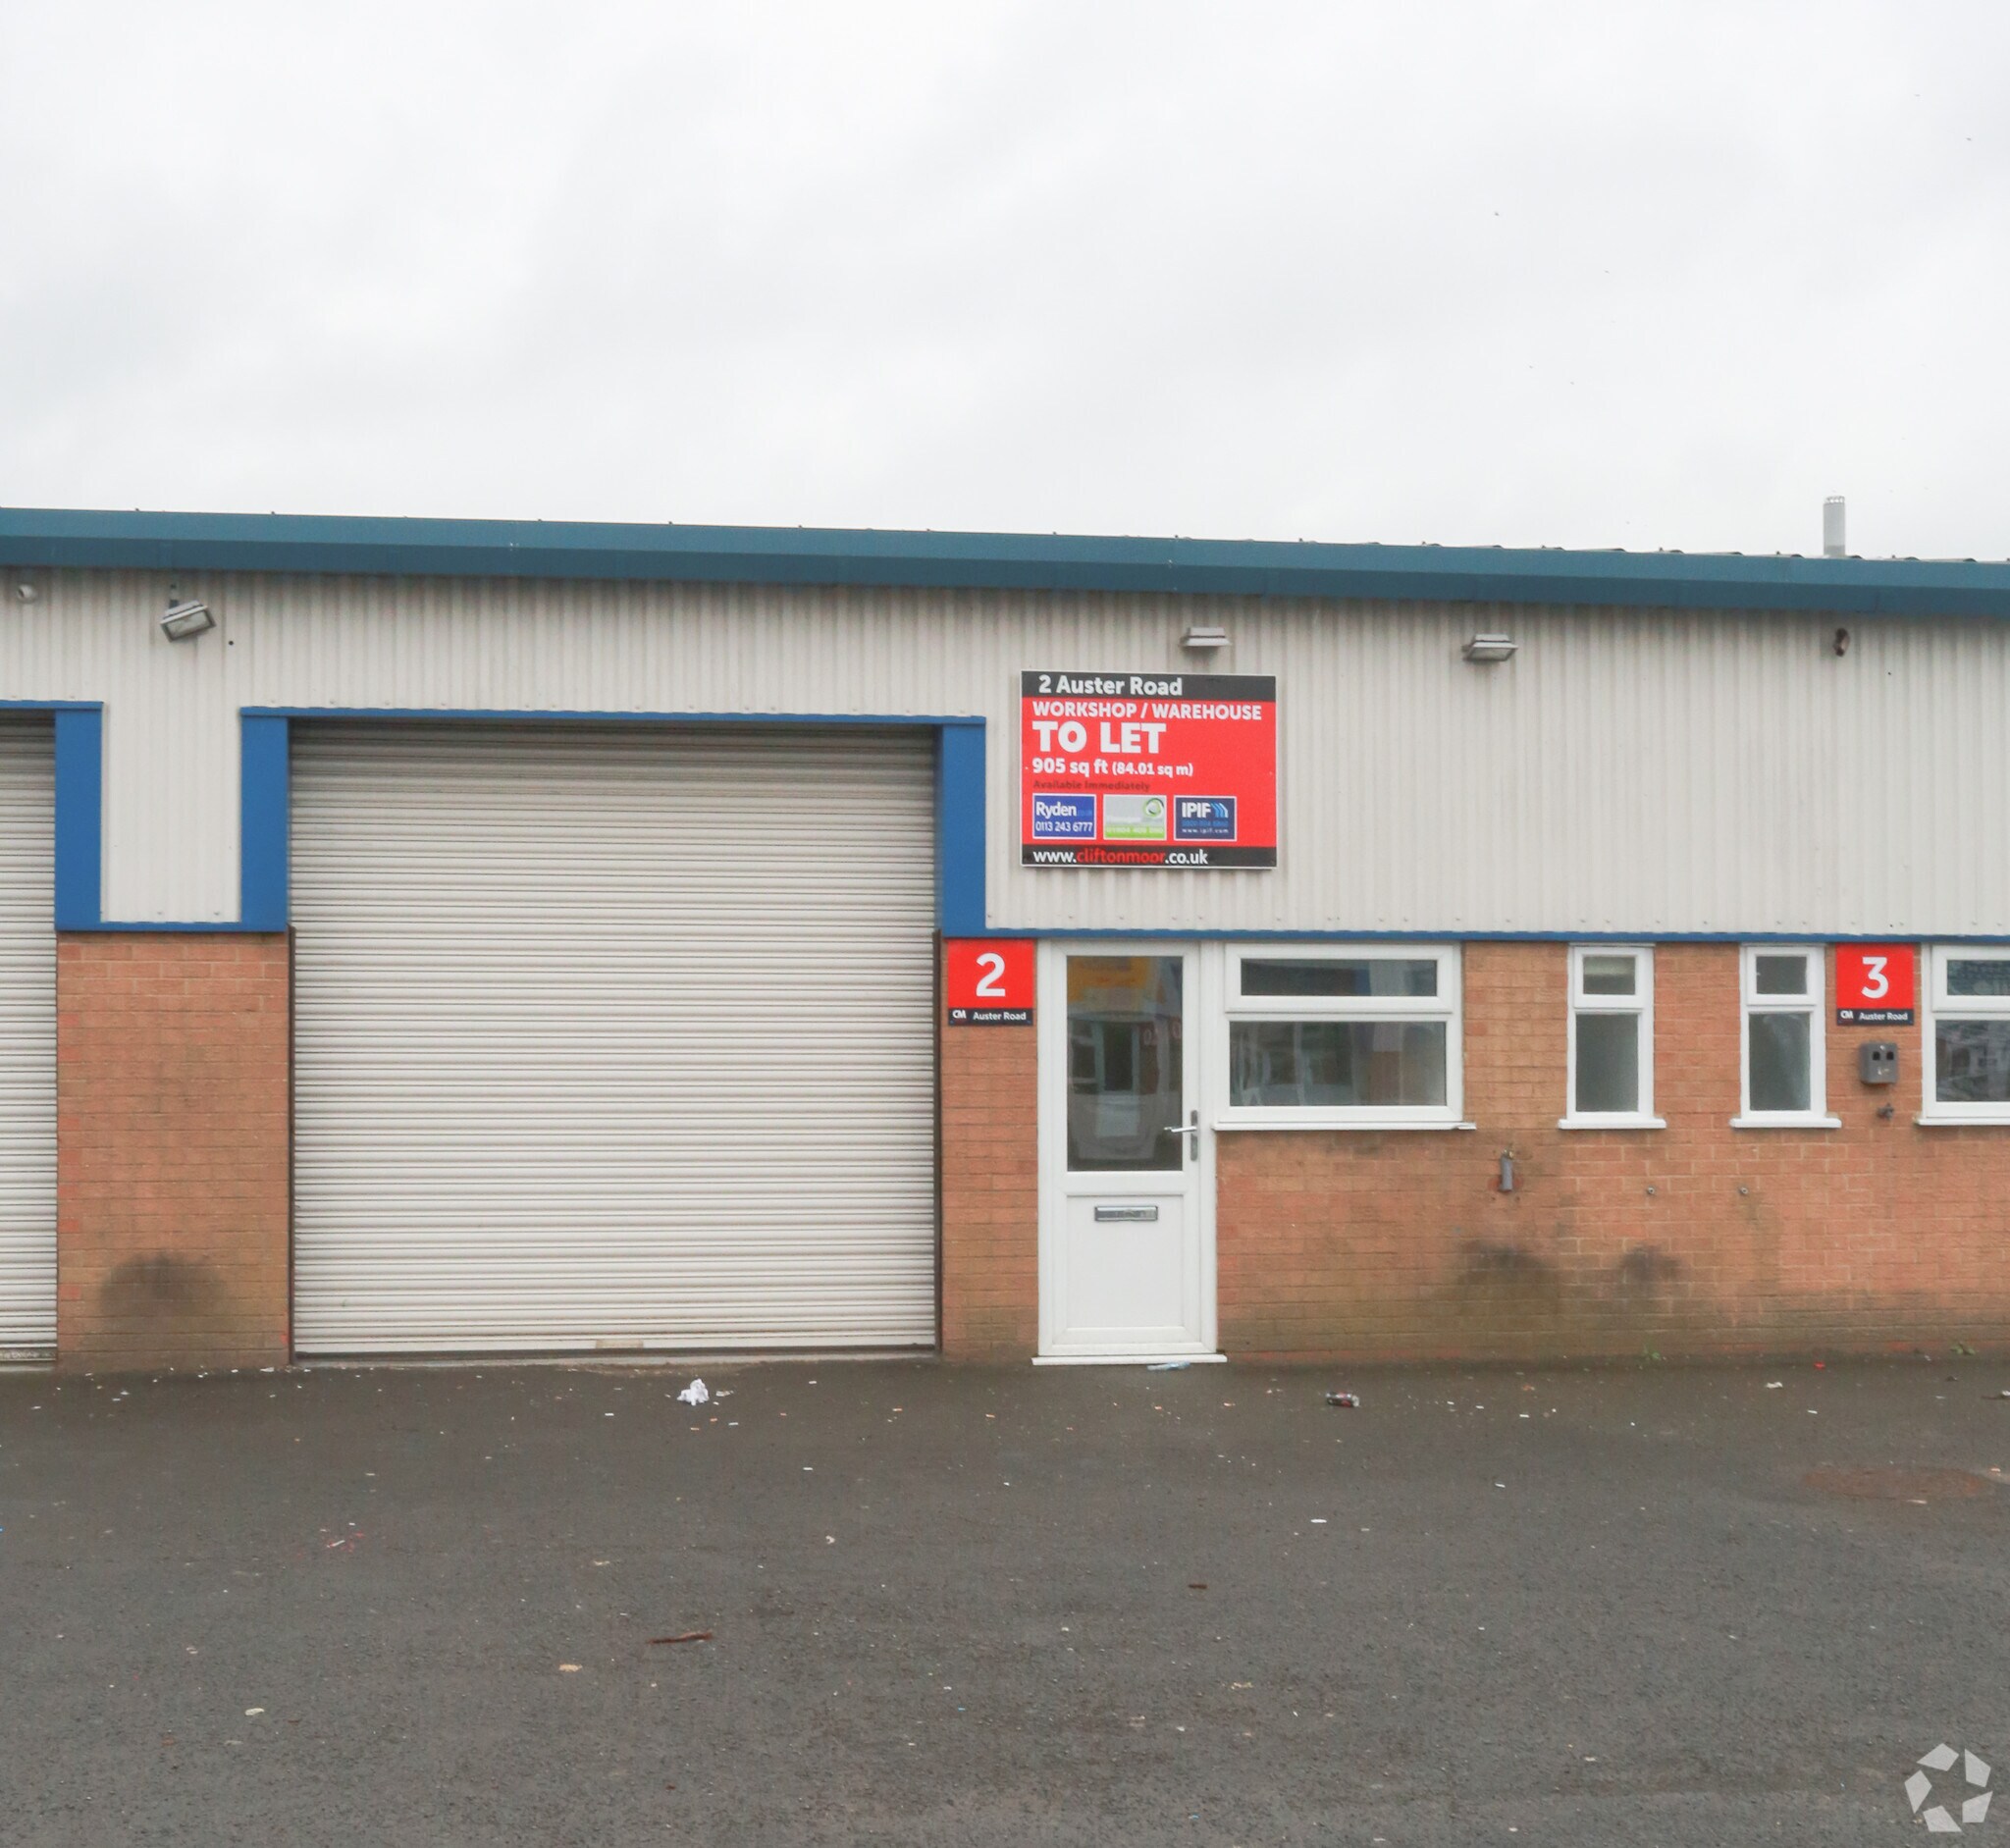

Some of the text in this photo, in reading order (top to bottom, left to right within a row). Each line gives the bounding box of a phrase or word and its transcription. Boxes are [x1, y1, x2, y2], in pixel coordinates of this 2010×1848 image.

[1038, 674, 1183, 696] 2 Auster Road
[1032, 701, 1137, 718] WORKSHOP
[1151, 703, 1262, 720] WAREHOUSE
[1032, 720, 1167, 754] TO LET
[1032, 758, 1193, 778] 905 sq ft (84.01 sq m)
[1034, 780, 1149, 792] Available Immediately
[1035, 801, 1077, 819] Ryden
[1182, 802, 1211, 818] IPIF
[1035, 821, 1053, 831] 0113
[1054, 821, 1071, 832] 243
[1073, 821, 1093, 832] 6777
[1033, 849, 1209, 865] www.cliftonmoor.co.uk
[976, 953, 1006, 997] 2
[1861, 956, 1888, 999] 3
[1859, 1012, 1885, 1021] Auster
[1886, 1012, 1908, 1021] Road
